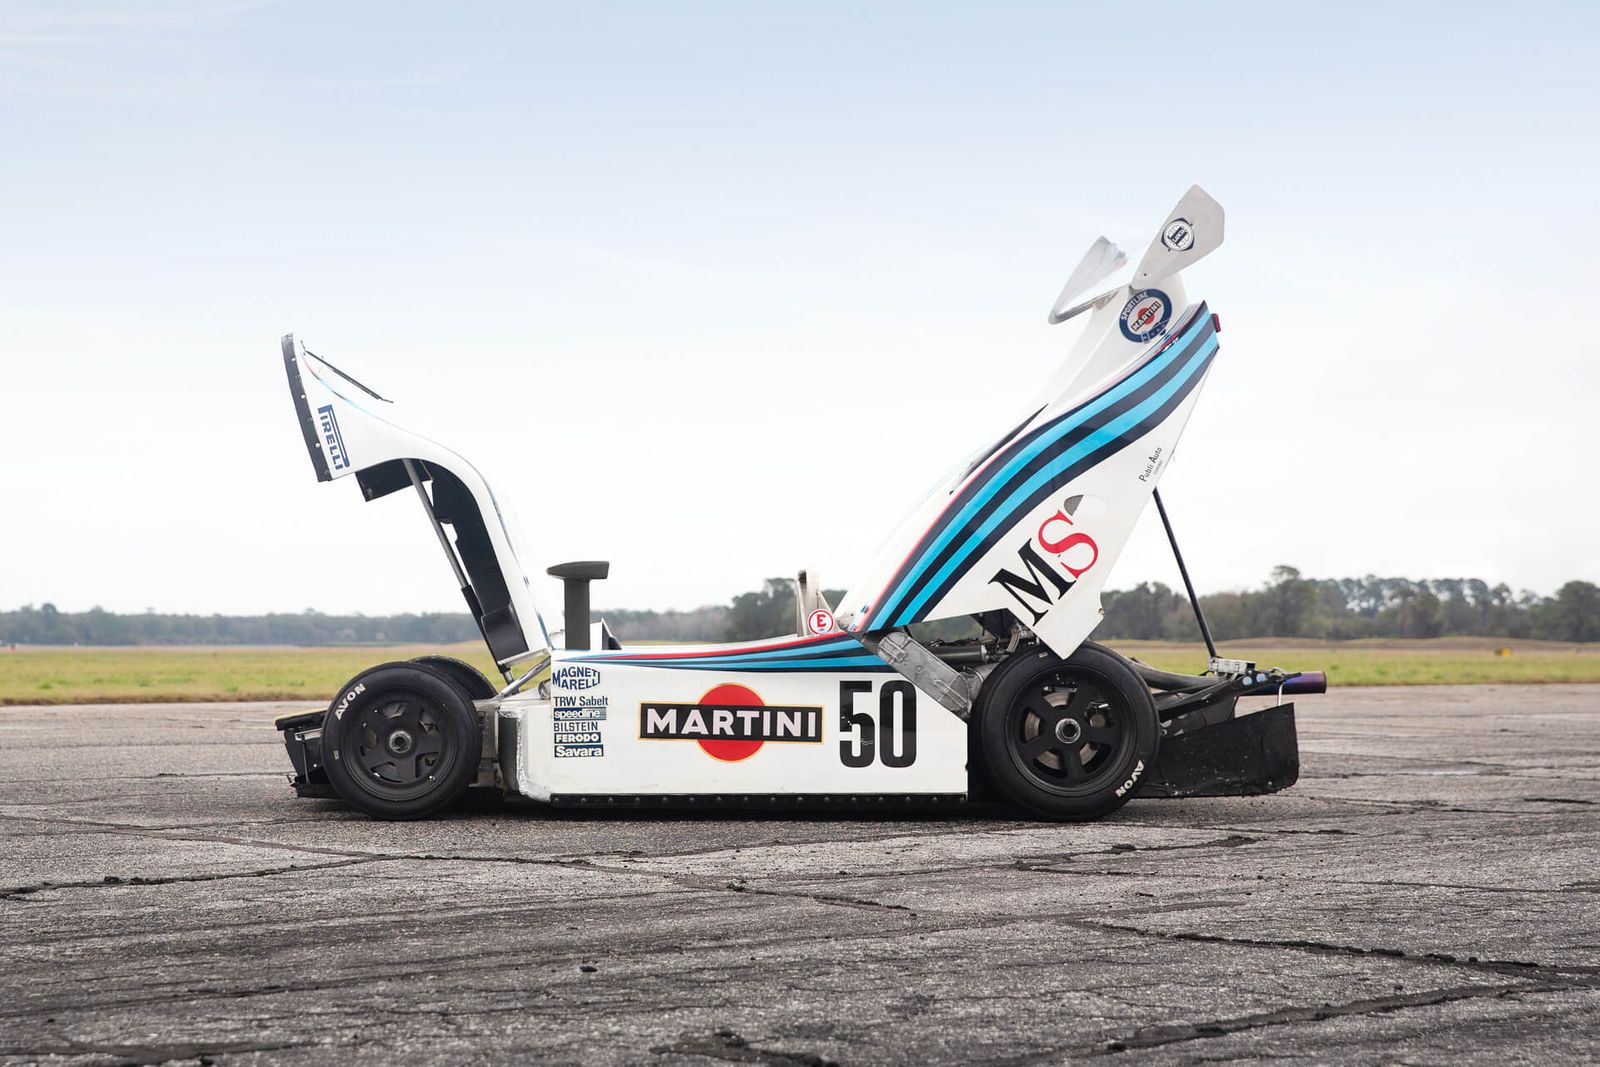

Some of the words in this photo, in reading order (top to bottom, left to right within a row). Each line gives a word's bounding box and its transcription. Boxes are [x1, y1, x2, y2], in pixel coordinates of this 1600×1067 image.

[1121, 290, 1149, 321] SPORTLINE
[1132, 301, 1161, 331] MARTINI
[317, 404, 350, 470] PIRELLI
[1148, 447, 1163, 464] Auto
[987, 509, 1099, 627] MS
[816, 613, 827, 628] E
[552, 666, 600, 683] MAGNETI
[552, 676, 600, 690] MARELLI
[335, 683, 366, 721] AVON
[553, 696, 577, 707] TRW
[579, 695, 609, 706] Sabelt
[553, 721, 598, 732] BILSTEIN
[646, 707, 817, 738] MARTINI
[839, 680, 917, 768] 50
[556, 733, 600, 743] FERODO
[556, 745, 603, 758] Savara
[1115, 759, 1145, 797] AVON
